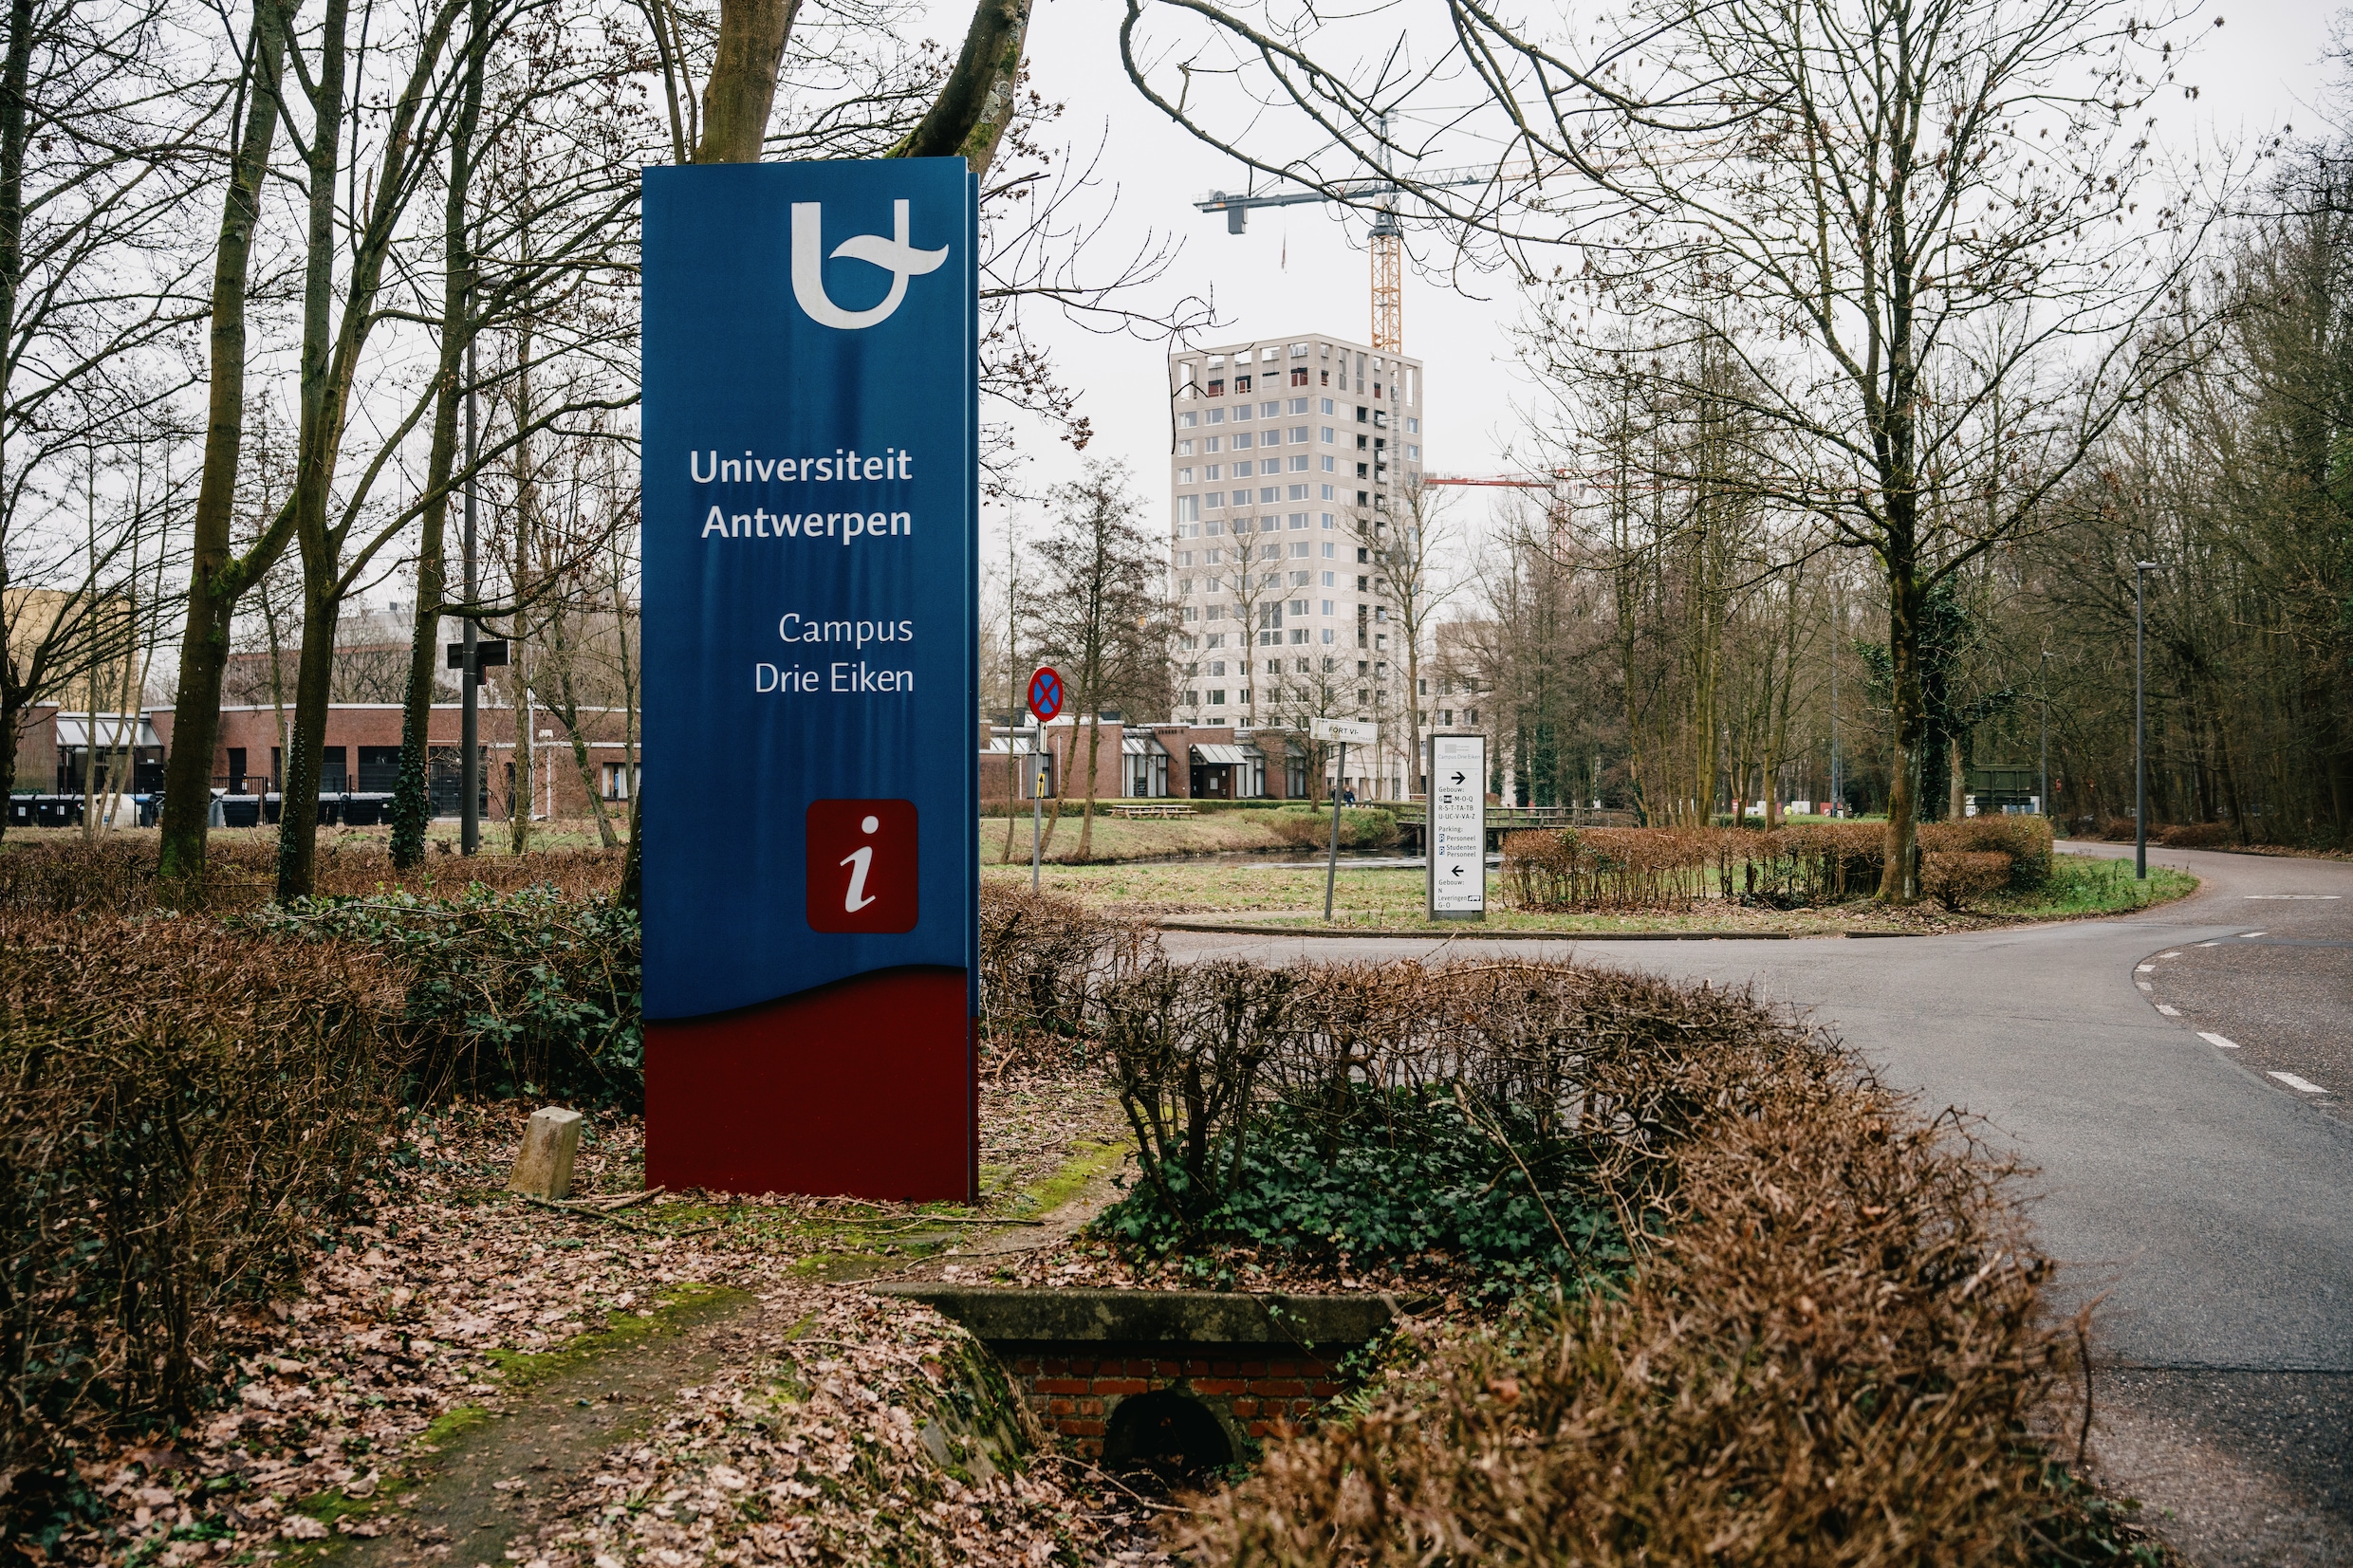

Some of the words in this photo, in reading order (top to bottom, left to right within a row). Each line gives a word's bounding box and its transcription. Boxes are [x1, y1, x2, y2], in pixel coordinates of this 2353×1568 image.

[690, 447, 913, 484] Universiteit
[700, 505, 912, 546] Antwerpen
[778, 612, 914, 650] Campus
[755, 662, 819, 692] Drie
[830, 660, 914, 692] Eiken
